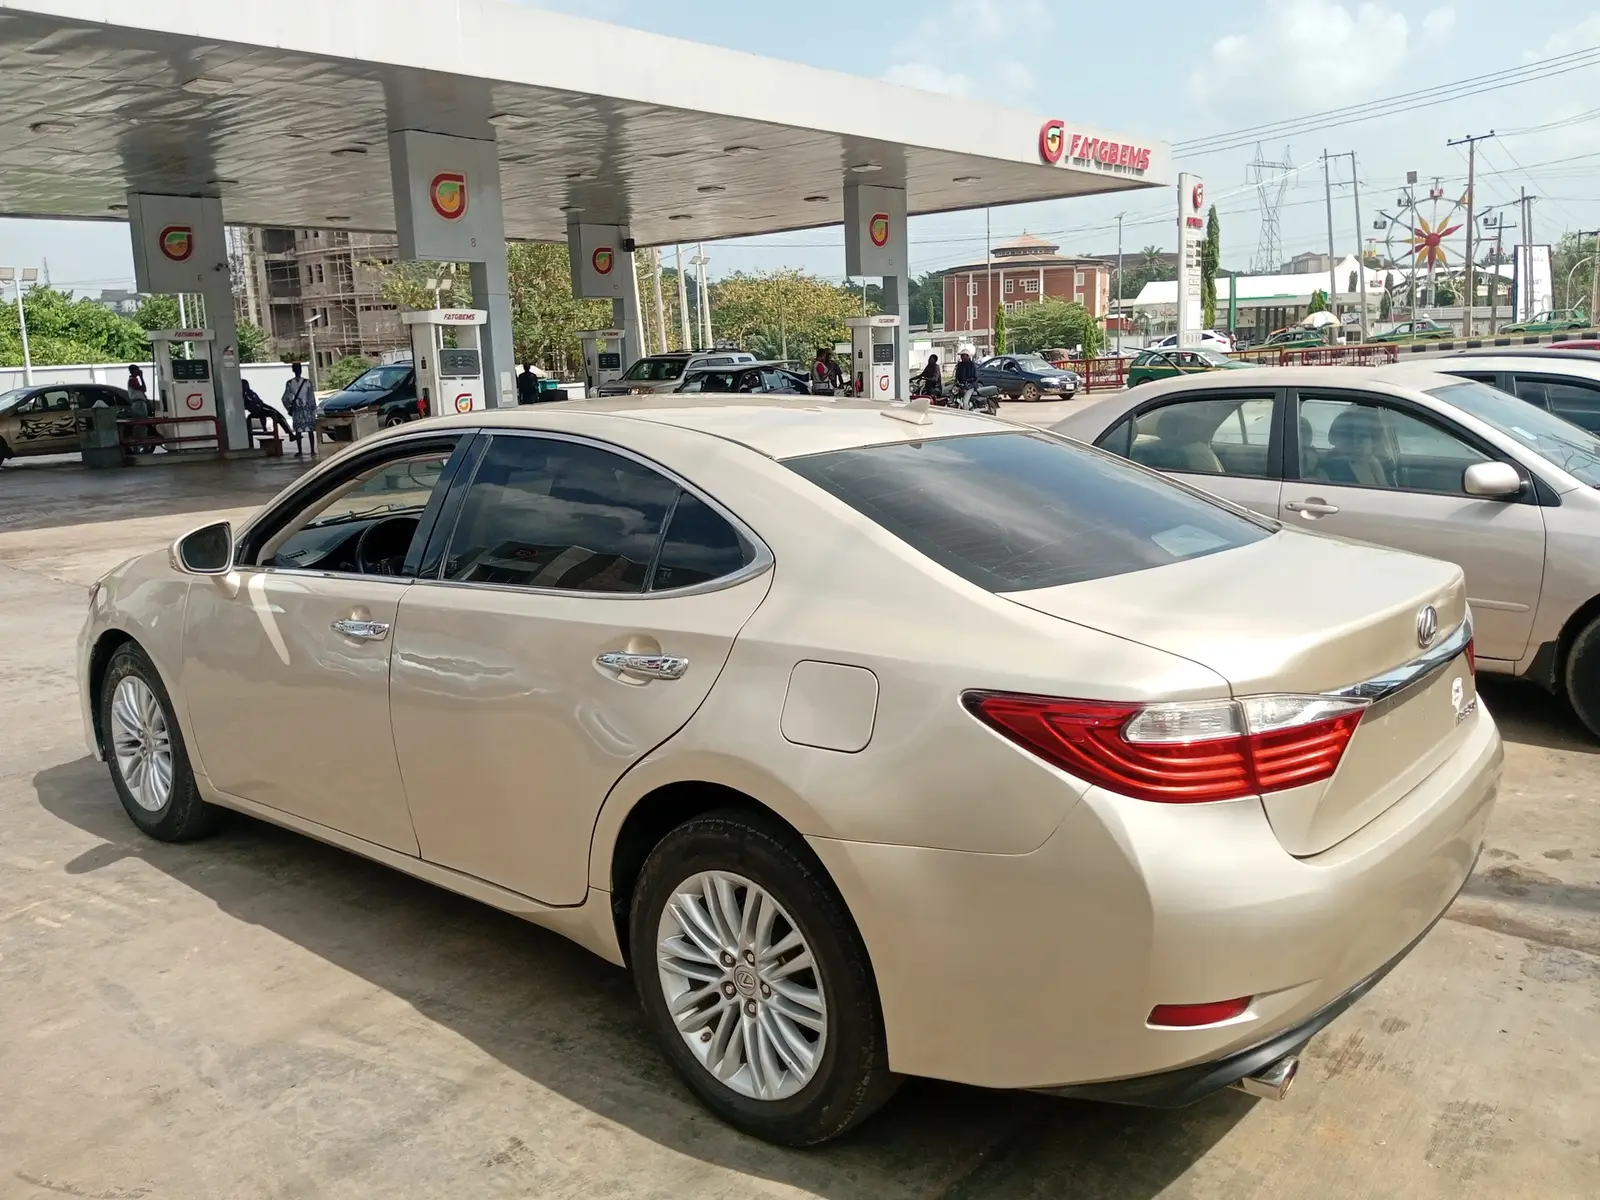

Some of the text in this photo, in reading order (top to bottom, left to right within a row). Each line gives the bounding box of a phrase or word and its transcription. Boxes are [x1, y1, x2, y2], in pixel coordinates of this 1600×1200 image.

[1069, 134, 1151, 170] FATGBEMS
[470, 237, 476, 247] 8
[444, 313, 476, 321] FATGBEMS
